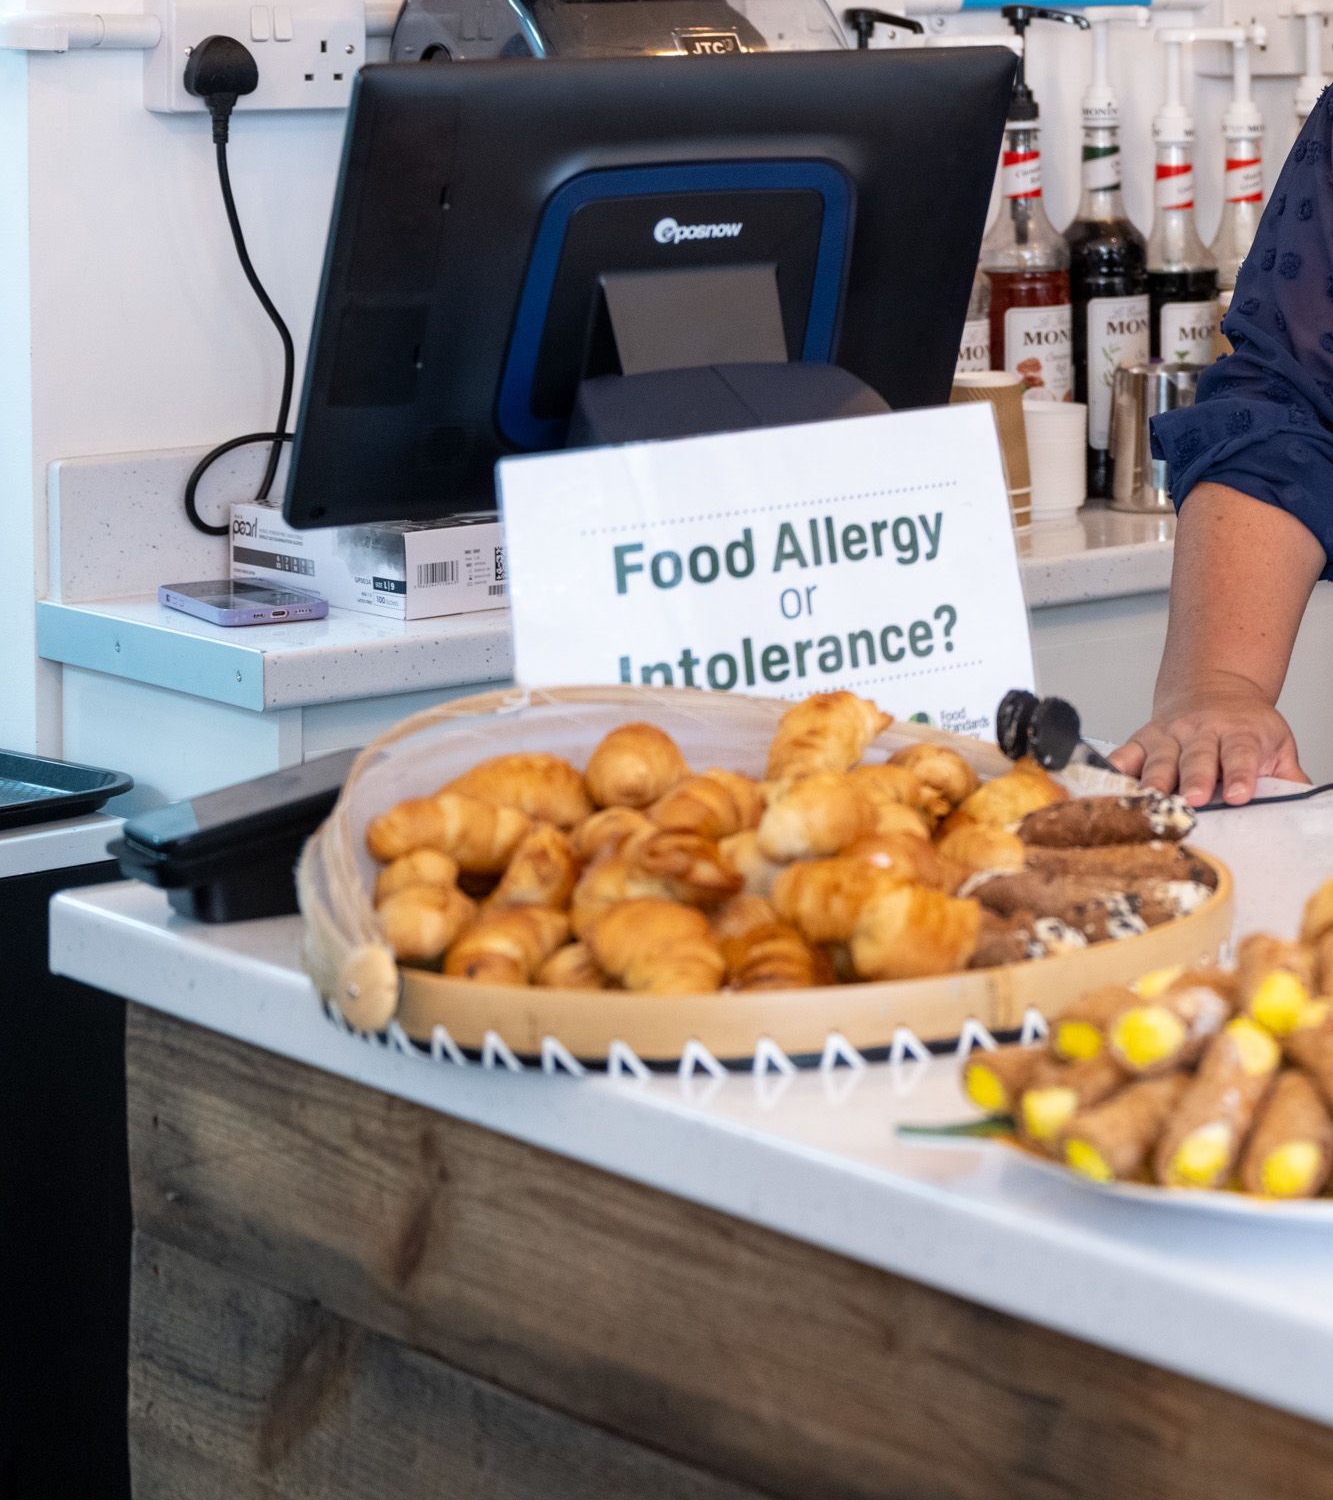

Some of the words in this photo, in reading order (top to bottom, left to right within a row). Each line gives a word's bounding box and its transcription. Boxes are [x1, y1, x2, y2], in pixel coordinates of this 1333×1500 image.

[692, 41, 726, 55] JTC
[232, 517, 258, 541] pearl
[613, 527, 756, 596] Food
[771, 511, 943, 574] Allergy
[779, 583, 818, 620] or
[618, 604, 958, 692] Intolerance?
